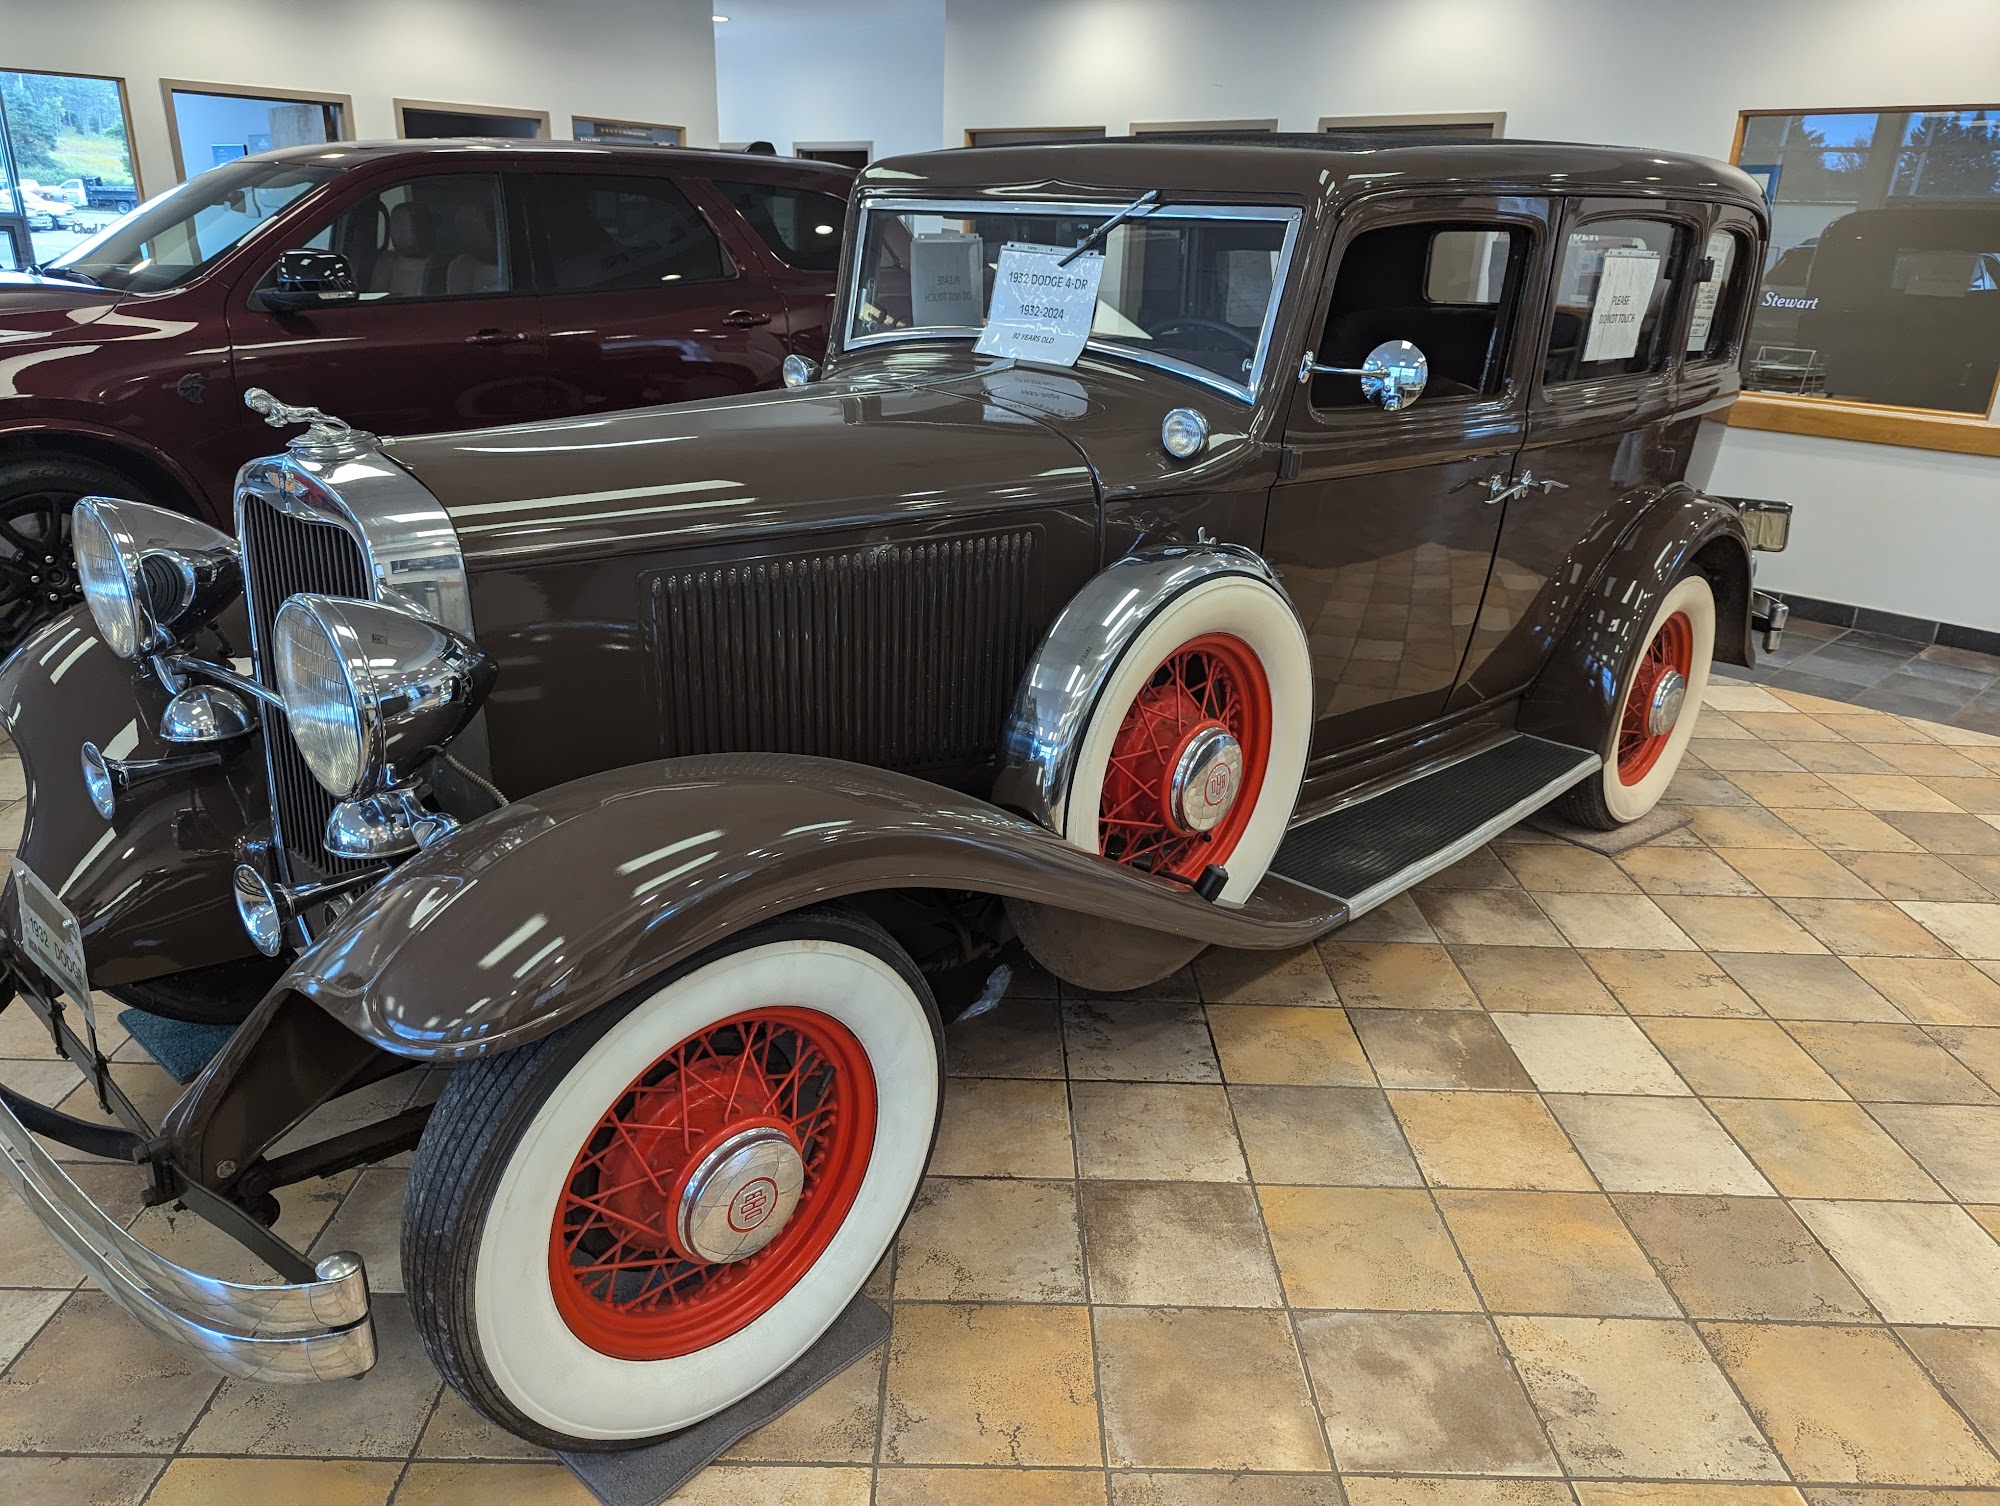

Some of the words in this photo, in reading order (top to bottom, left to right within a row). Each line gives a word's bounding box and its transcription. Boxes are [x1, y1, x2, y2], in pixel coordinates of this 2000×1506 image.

[72, 222, 97, 234] Chad
[1009, 272, 1029, 284] 1932
[1031, 274, 1063, 288] DODGE
[1065, 278, 1088, 290] 4-DR
[1611, 295, 1630, 306] PLEASE
[1761, 291, 1818, 309] Stewart
[1019, 304, 1064, 320] 1932-2024
[1021, 333, 1040, 342] YEARS
[1041, 336, 1055, 344] OLD
[30, 917, 49, 949] 1932
[53, 942, 83, 985] DODGE
